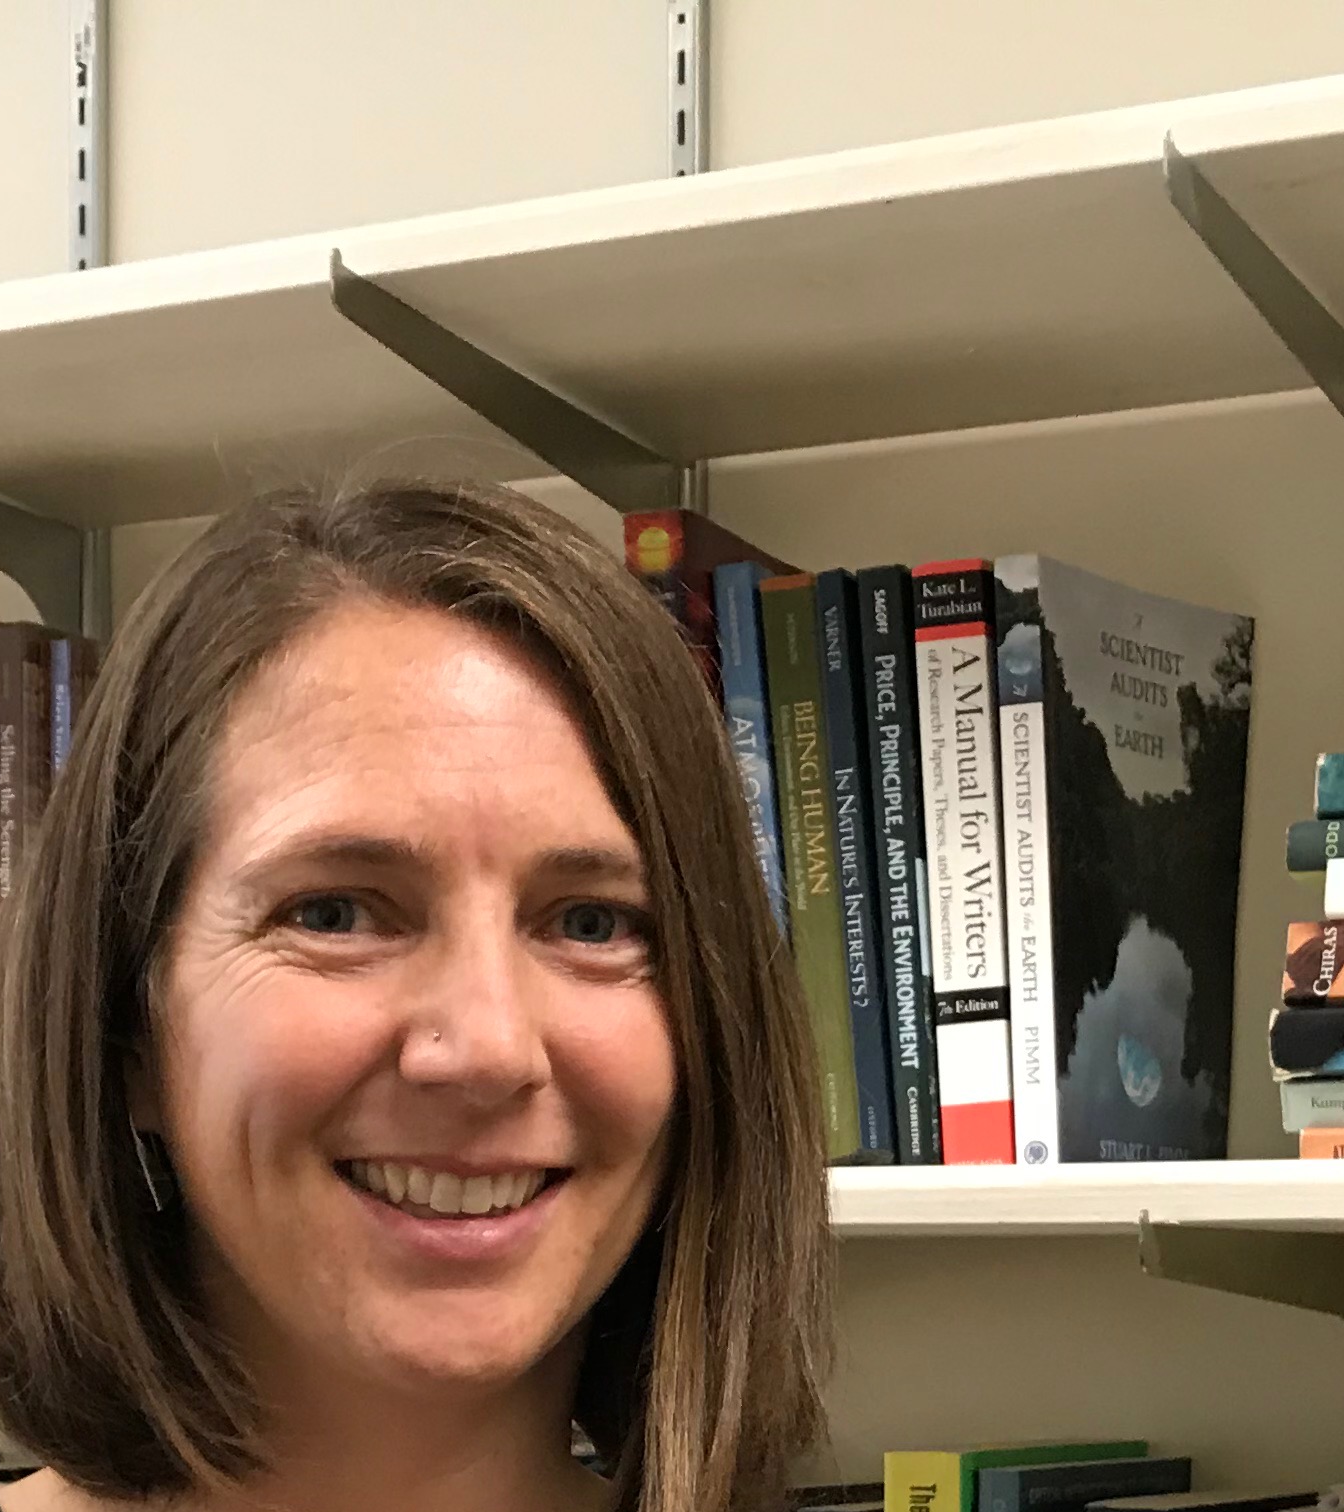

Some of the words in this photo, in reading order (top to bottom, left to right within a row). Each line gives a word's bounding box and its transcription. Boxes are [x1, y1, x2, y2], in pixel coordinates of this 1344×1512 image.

[873, 588, 889, 635] SAGOFF
[918, 598, 984, 619] Turabian
[923, 579, 953, 598] Kate
[825, 606, 842, 672] VARNER
[927, 648, 944, 665] of
[950, 647, 982, 676] A
[873, 655, 898, 721] PRICE,
[929, 667, 950, 733] Research
[793, 702, 820, 781] BEING
[929, 739, 952, 792] Papers,
[955, 685, 991, 800] Manual
[1013, 711, 1033, 822] SCIENTIST
[878, 726, 905, 834] PRINCIPLE,
[801, 789, 830, 896] HUMAN
[887, 838, 908, 880] AND
[959, 810, 992, 854] for
[834, 768, 854, 791] IN
[845, 893, 869, 1008] INTERESTS?
[889, 883, 910, 920] THE
[937, 855, 954, 882] and
[1017, 829, 1036, 908] AUDITS
[939, 887, 957, 981] Dissertations
[961, 864, 993, 980] Writers
[1020, 936, 1038, 1003] EARTH
[1313, 926, 1338, 997] CHIRAS
[891, 926, 919, 1069] ENVIRONMENT
[1023, 1026, 1041, 1086] PIMM
